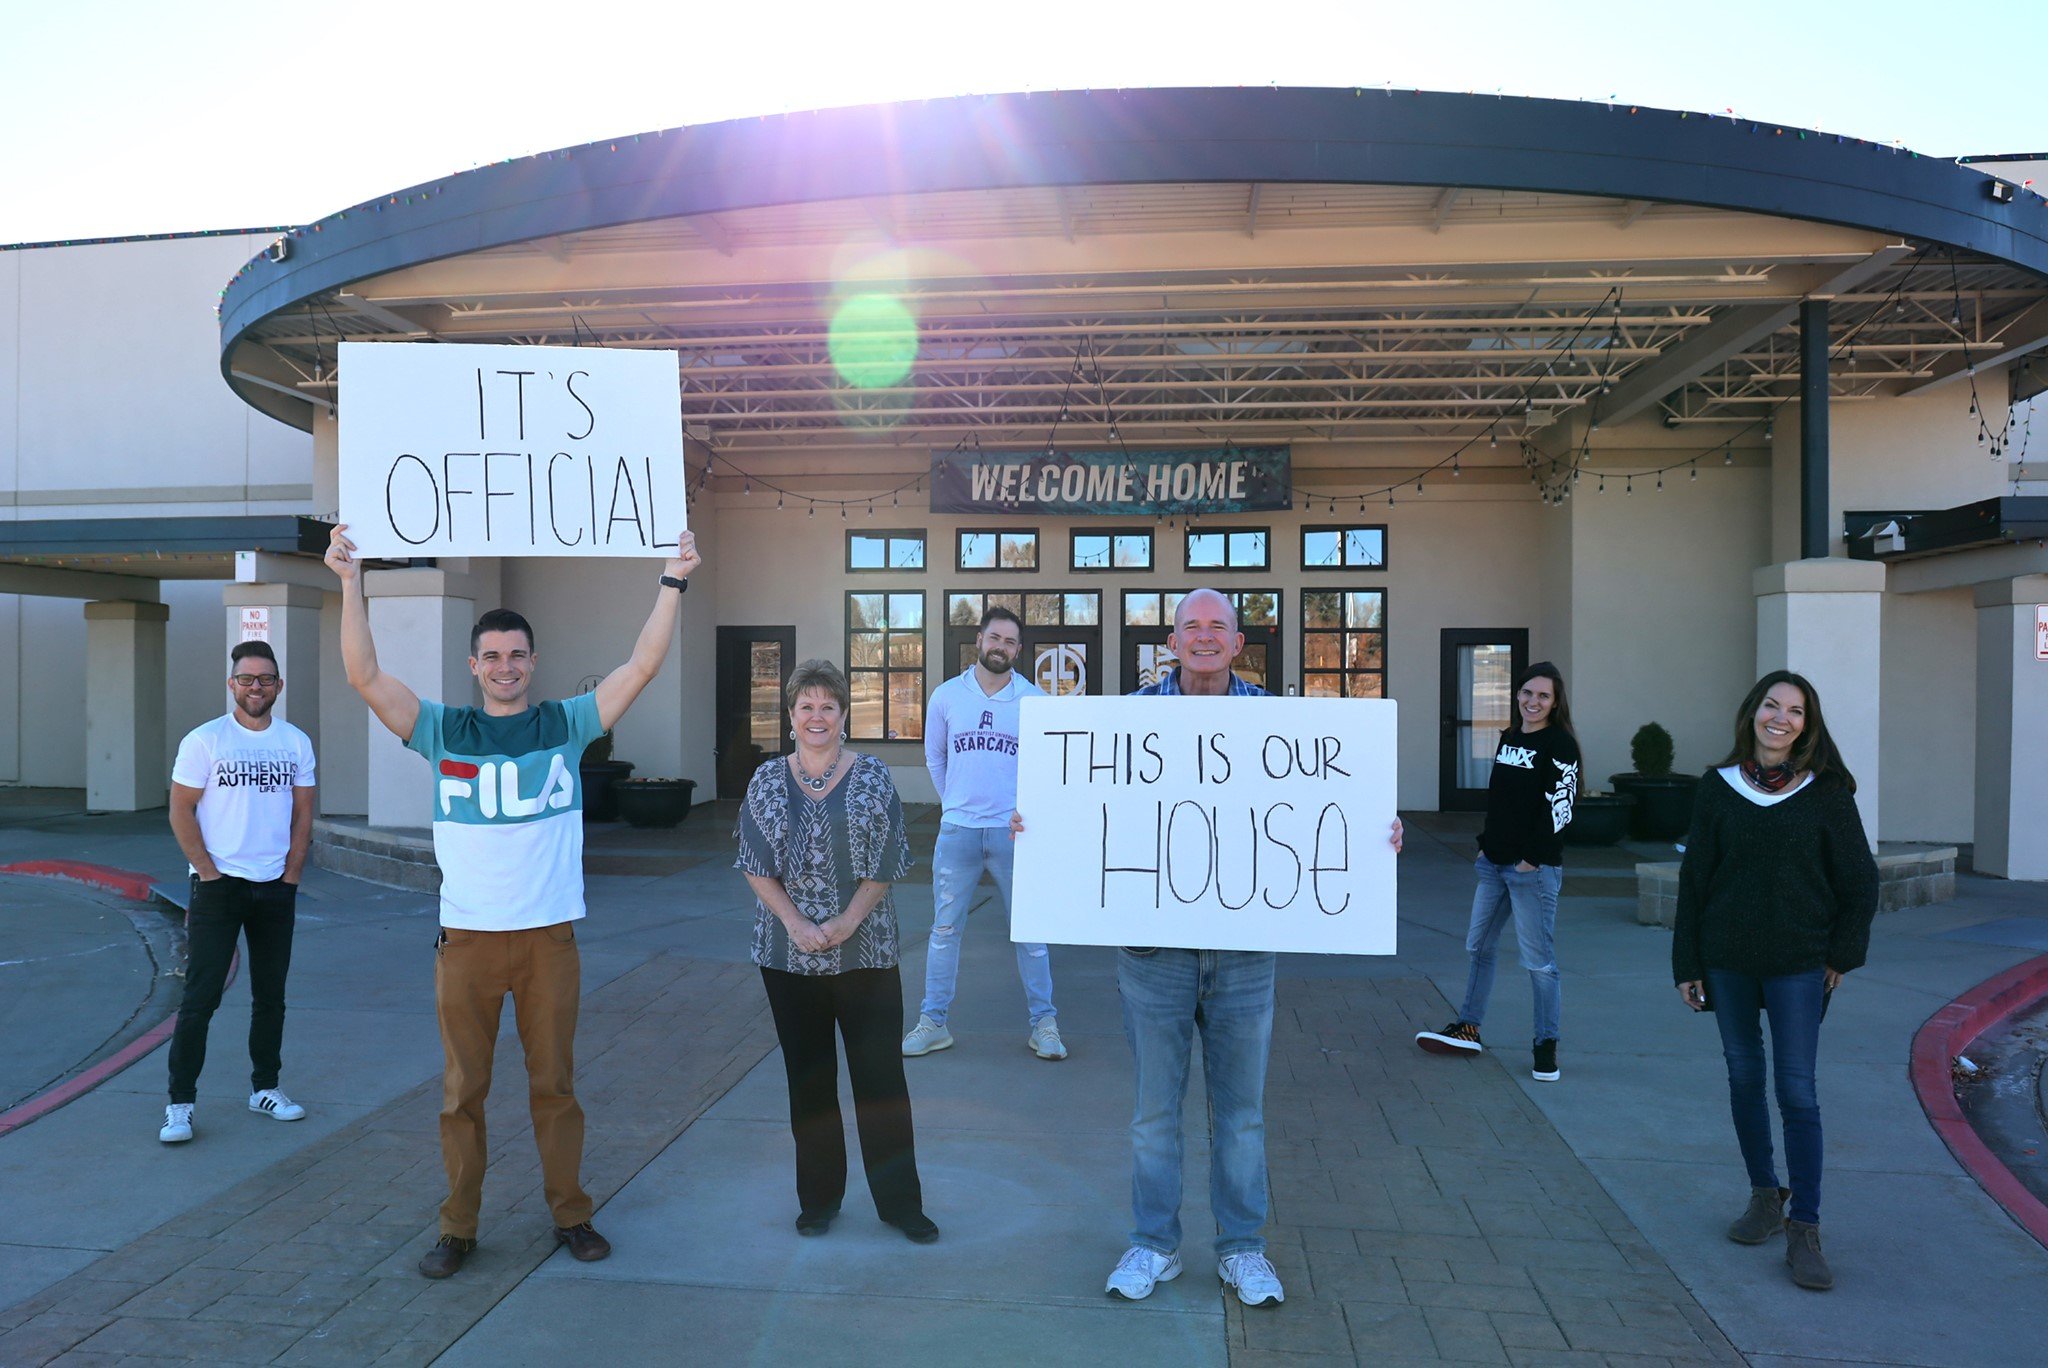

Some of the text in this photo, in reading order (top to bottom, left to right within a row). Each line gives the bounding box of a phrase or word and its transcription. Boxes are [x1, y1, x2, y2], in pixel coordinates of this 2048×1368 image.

[477, 367, 594, 440] IT'S
[386, 452, 679, 548] OFFICIAL
[971, 461, 1248, 503] WELCOME HOME
[242, 621, 267, 631] PARKING
[249, 610, 260, 620] NO
[954, 736, 1019, 756] BEARCATS
[1044, 731, 1351, 785] THIS IS OUR
[439, 753, 574, 819] FILA
